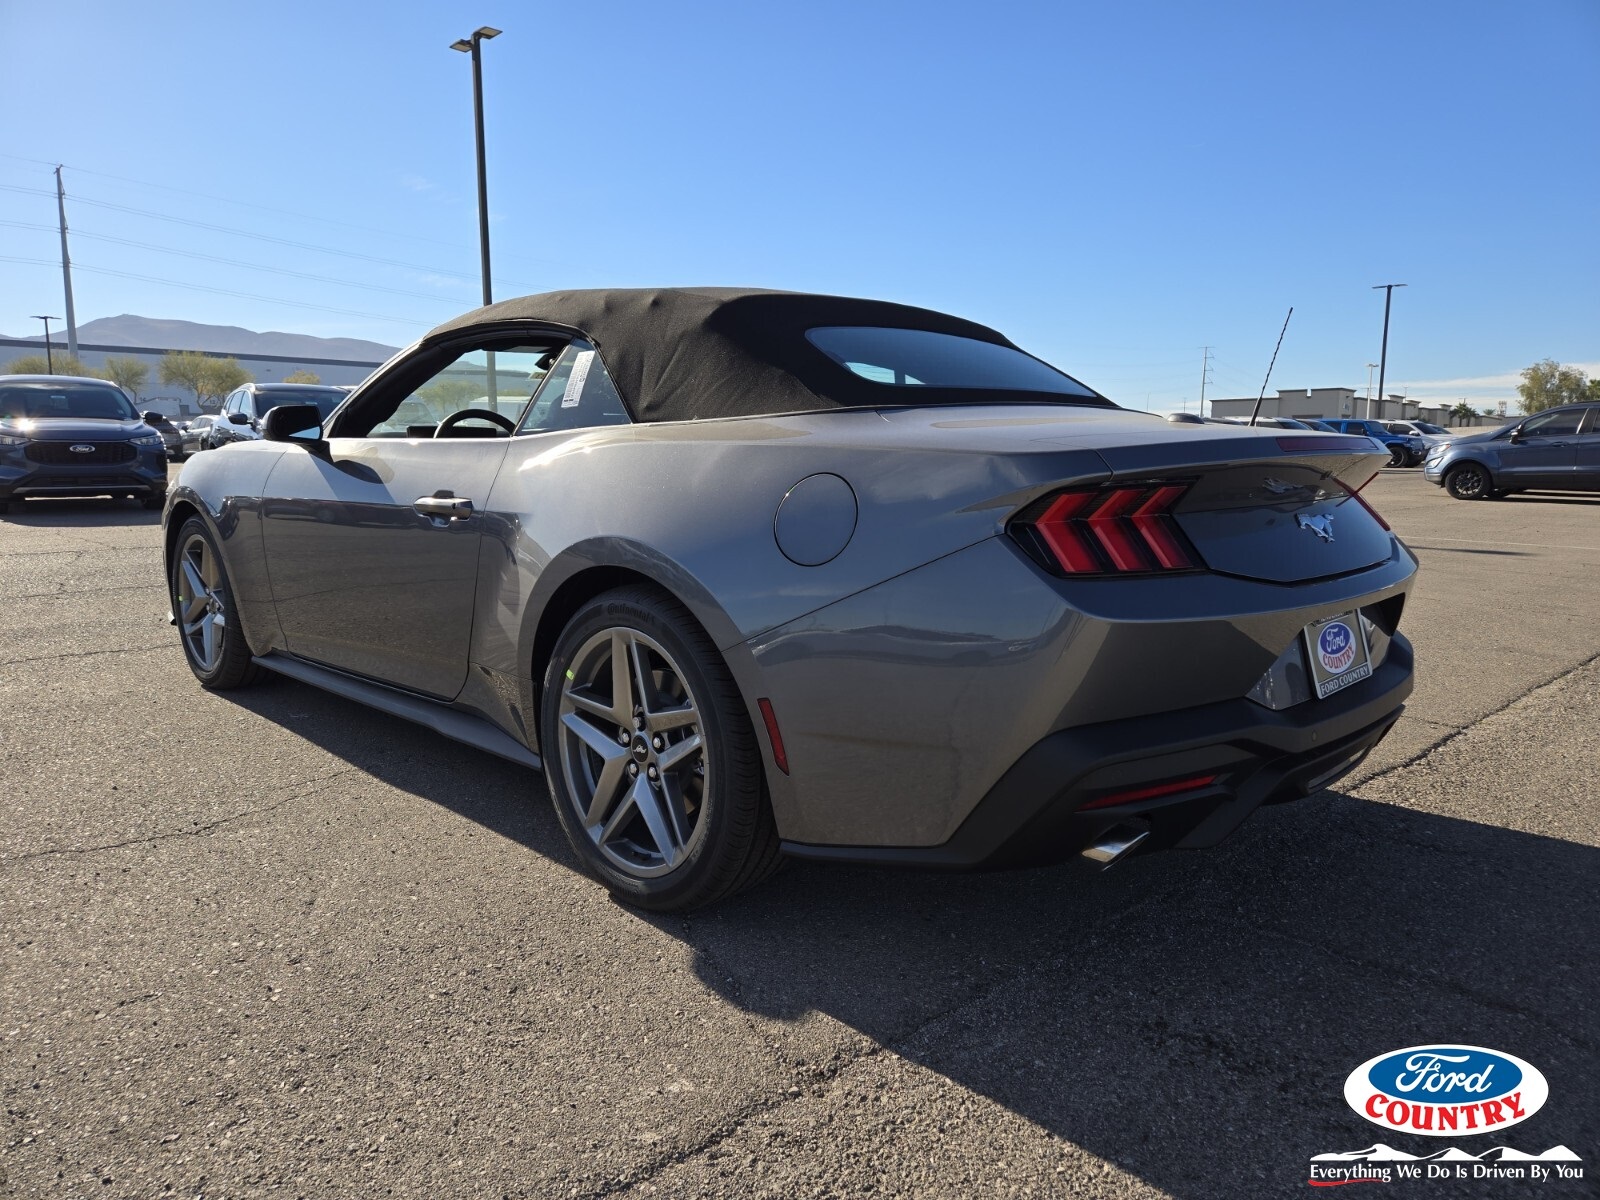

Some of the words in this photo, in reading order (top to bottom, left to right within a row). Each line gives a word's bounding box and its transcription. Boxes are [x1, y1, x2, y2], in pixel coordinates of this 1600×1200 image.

[1326, 627, 1346, 652] Ford
[1322, 642, 1354, 669] COUNTRY
[1320, 680, 1339, 695] FORD
[1339, 666, 1369, 686] COUNTRY
